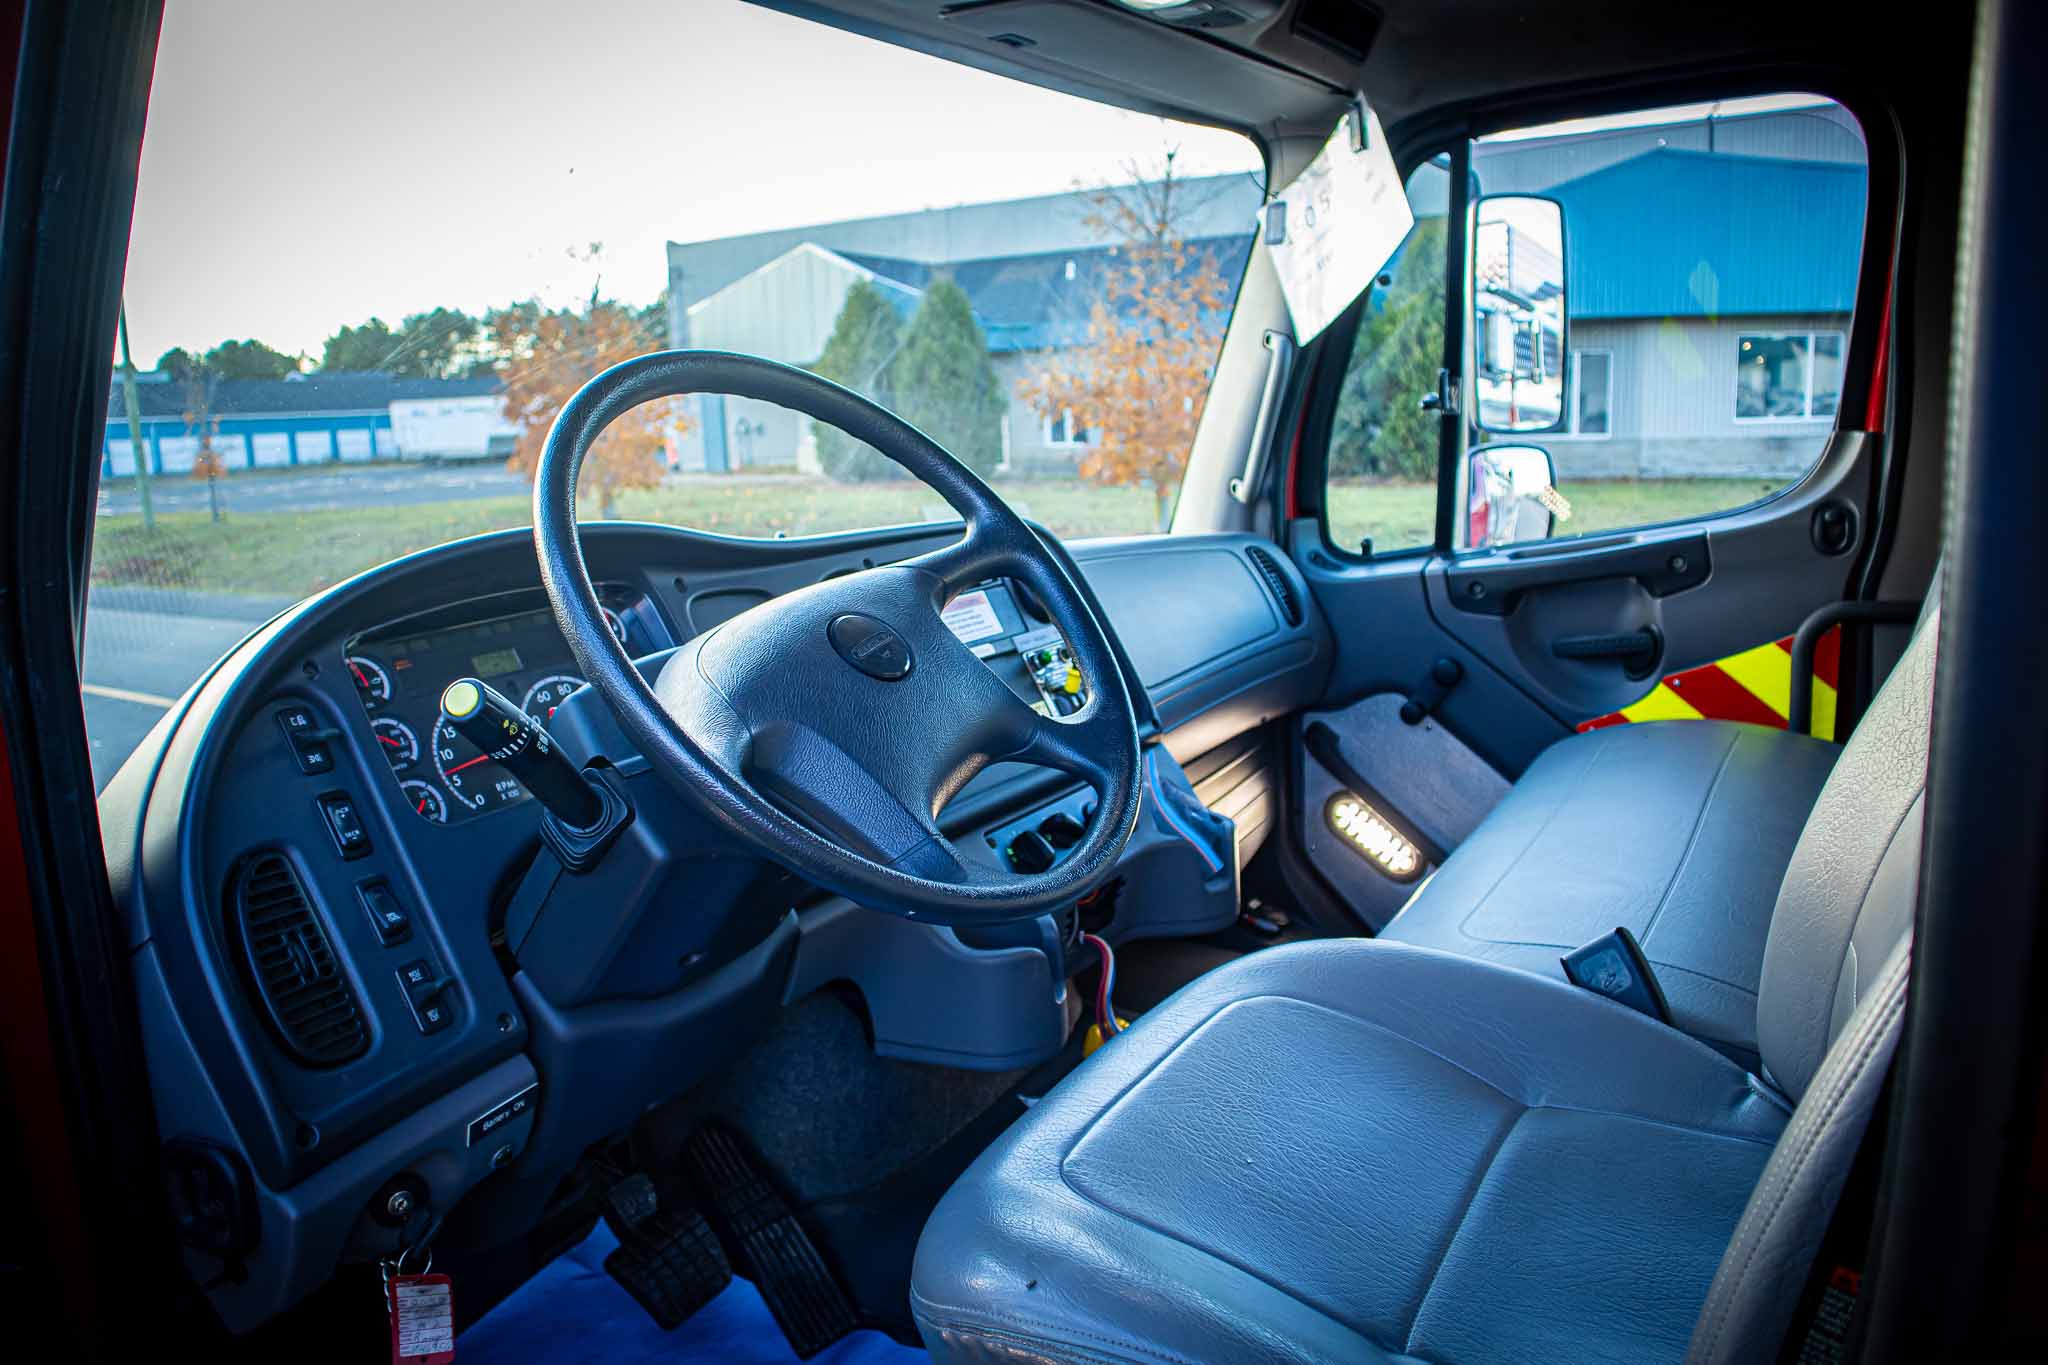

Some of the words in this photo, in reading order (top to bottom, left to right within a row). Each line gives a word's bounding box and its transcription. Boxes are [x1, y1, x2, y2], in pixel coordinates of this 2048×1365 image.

[557, 683, 572, 696] 80
[537, 690, 551, 703] 60
[442, 726, 456, 740] 15
[440, 748, 454, 761] 10
[452, 775, 462, 787] 5
[495, 779, 517, 793] RPM
[474, 794, 485, 806] 0
